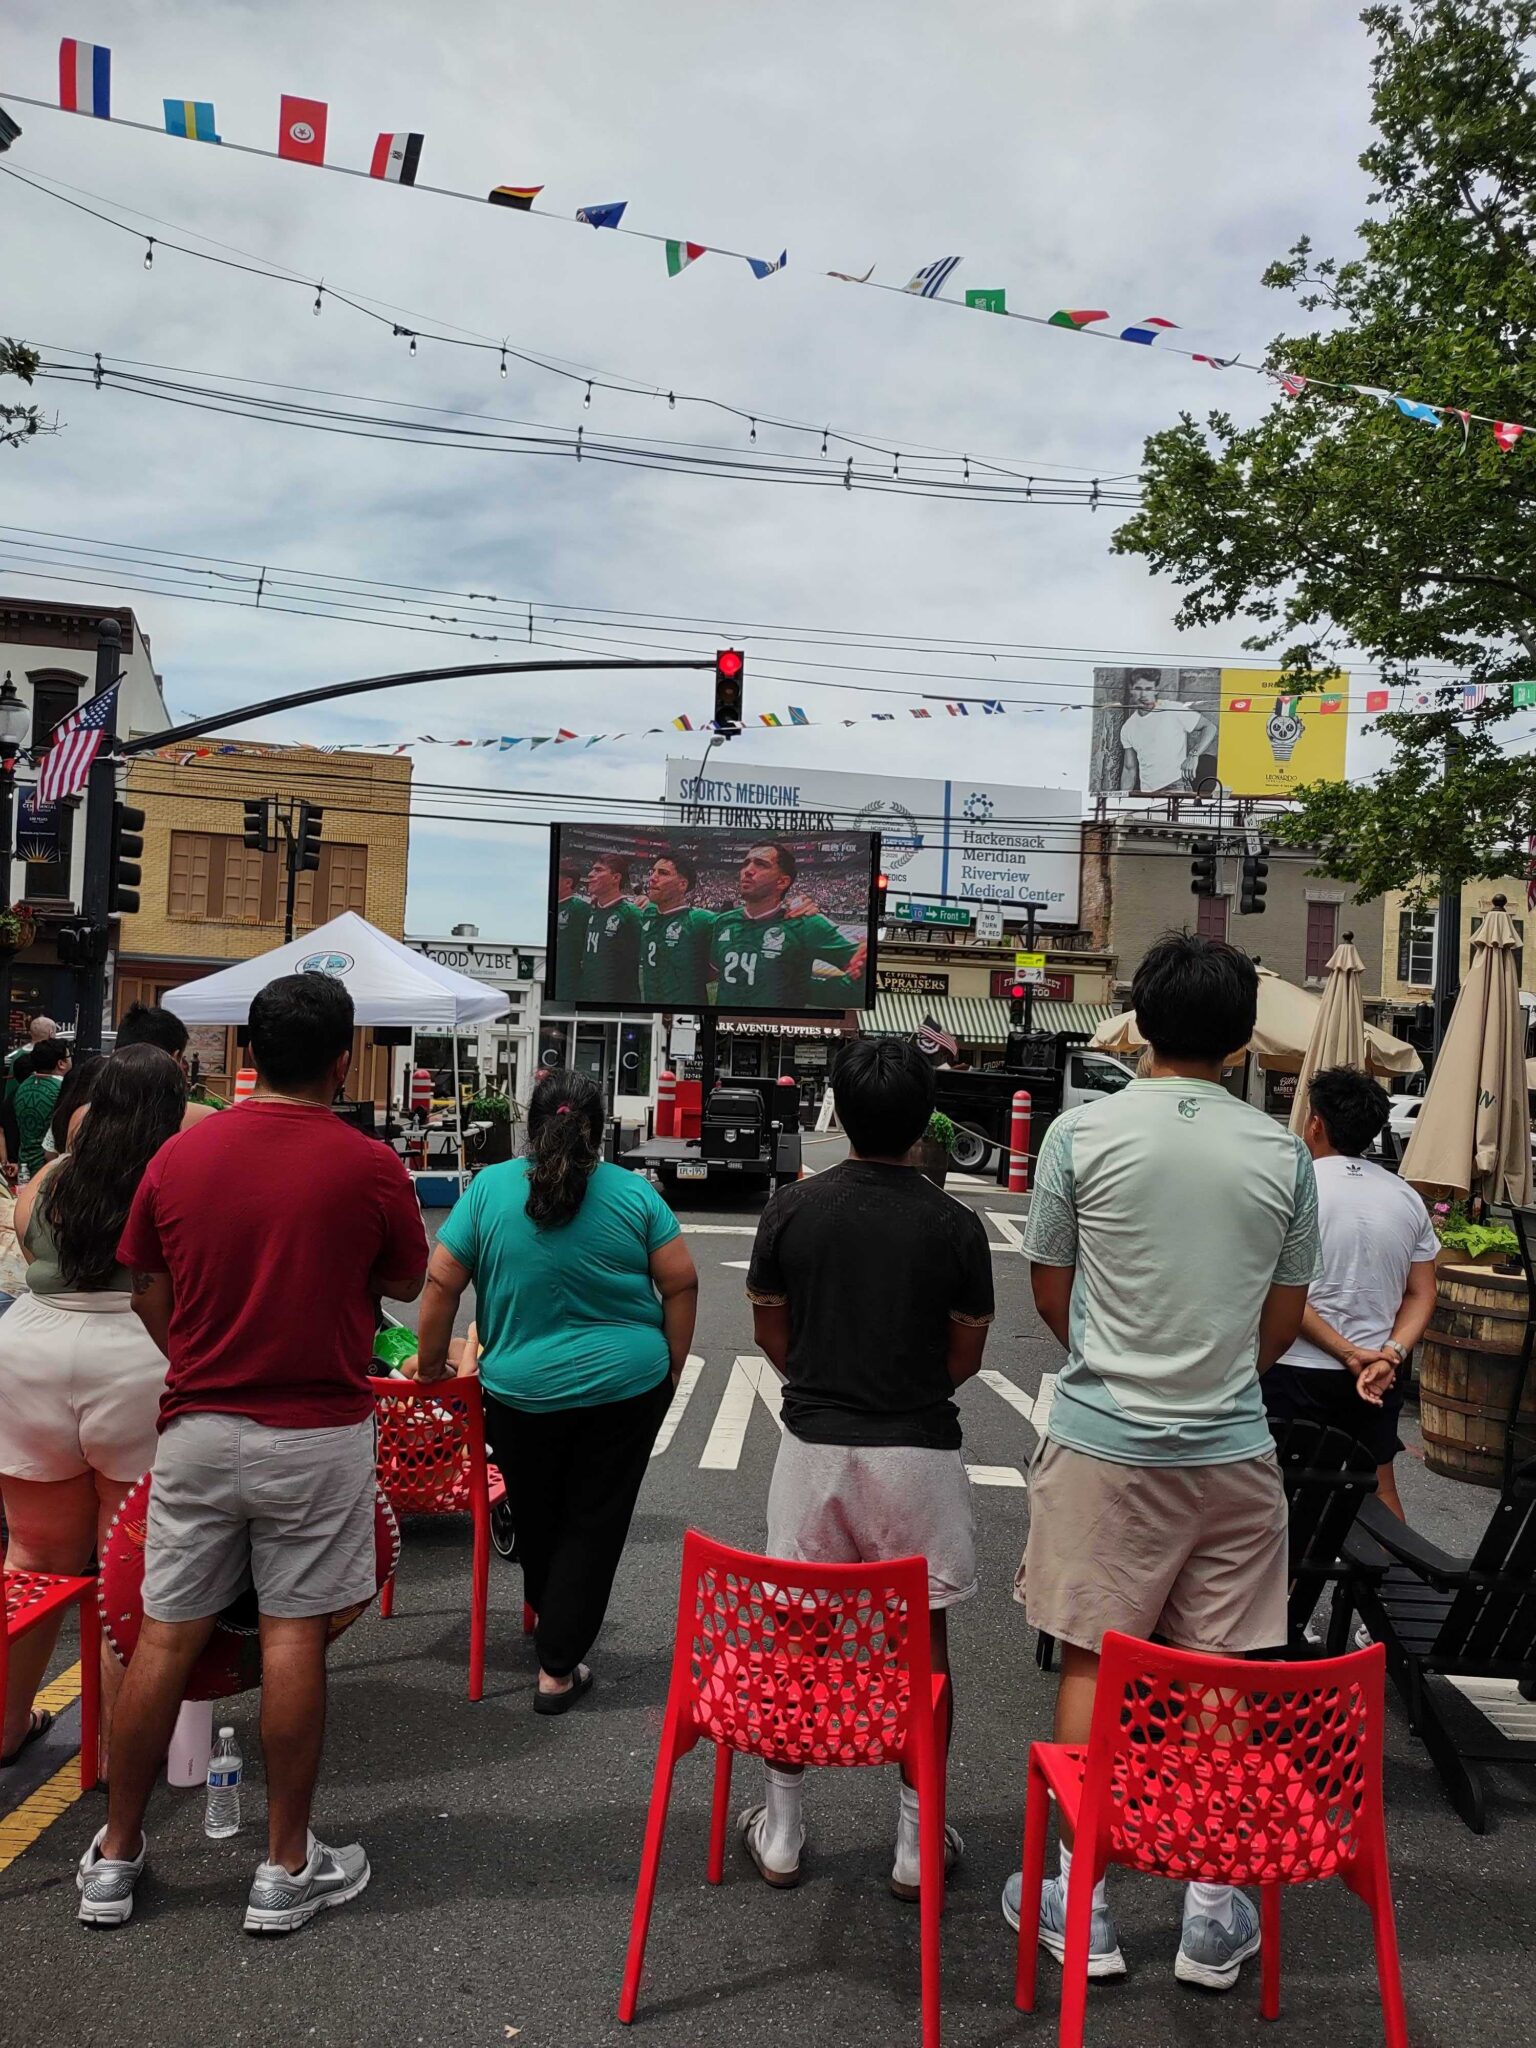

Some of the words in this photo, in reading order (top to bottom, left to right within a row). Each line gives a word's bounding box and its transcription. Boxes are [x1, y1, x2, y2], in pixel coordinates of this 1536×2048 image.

[679, 778, 732, 802] SPORTS
[735, 783, 801, 807] MEDICINE
[719, 807, 763, 829] TURNS
[765, 810, 834, 832] SETBACKS
[962, 829, 1045, 849] Hackensack
[962, 849, 1027, 865] Meridian
[887, 873, 907, 883] EDICS
[961, 865, 1031, 882] Riverview
[960, 882, 1015, 899] Medical
[1018, 886, 1065, 902] Center
[940, 910, 959, 921] Front
[586, 931, 600, 953] 14
[426, 950, 469, 968] GOOD
[474, 952, 512, 970] VIBE
[647, 941, 657, 967] 2
[724, 951, 758, 986] 24
[876, 972, 946, 990] APPRAISERS
[715, 1022, 735, 1032] ARK
[735, 1023, 779, 1034] AVENUE
[780, 1025, 822, 1035] PUPPIES
